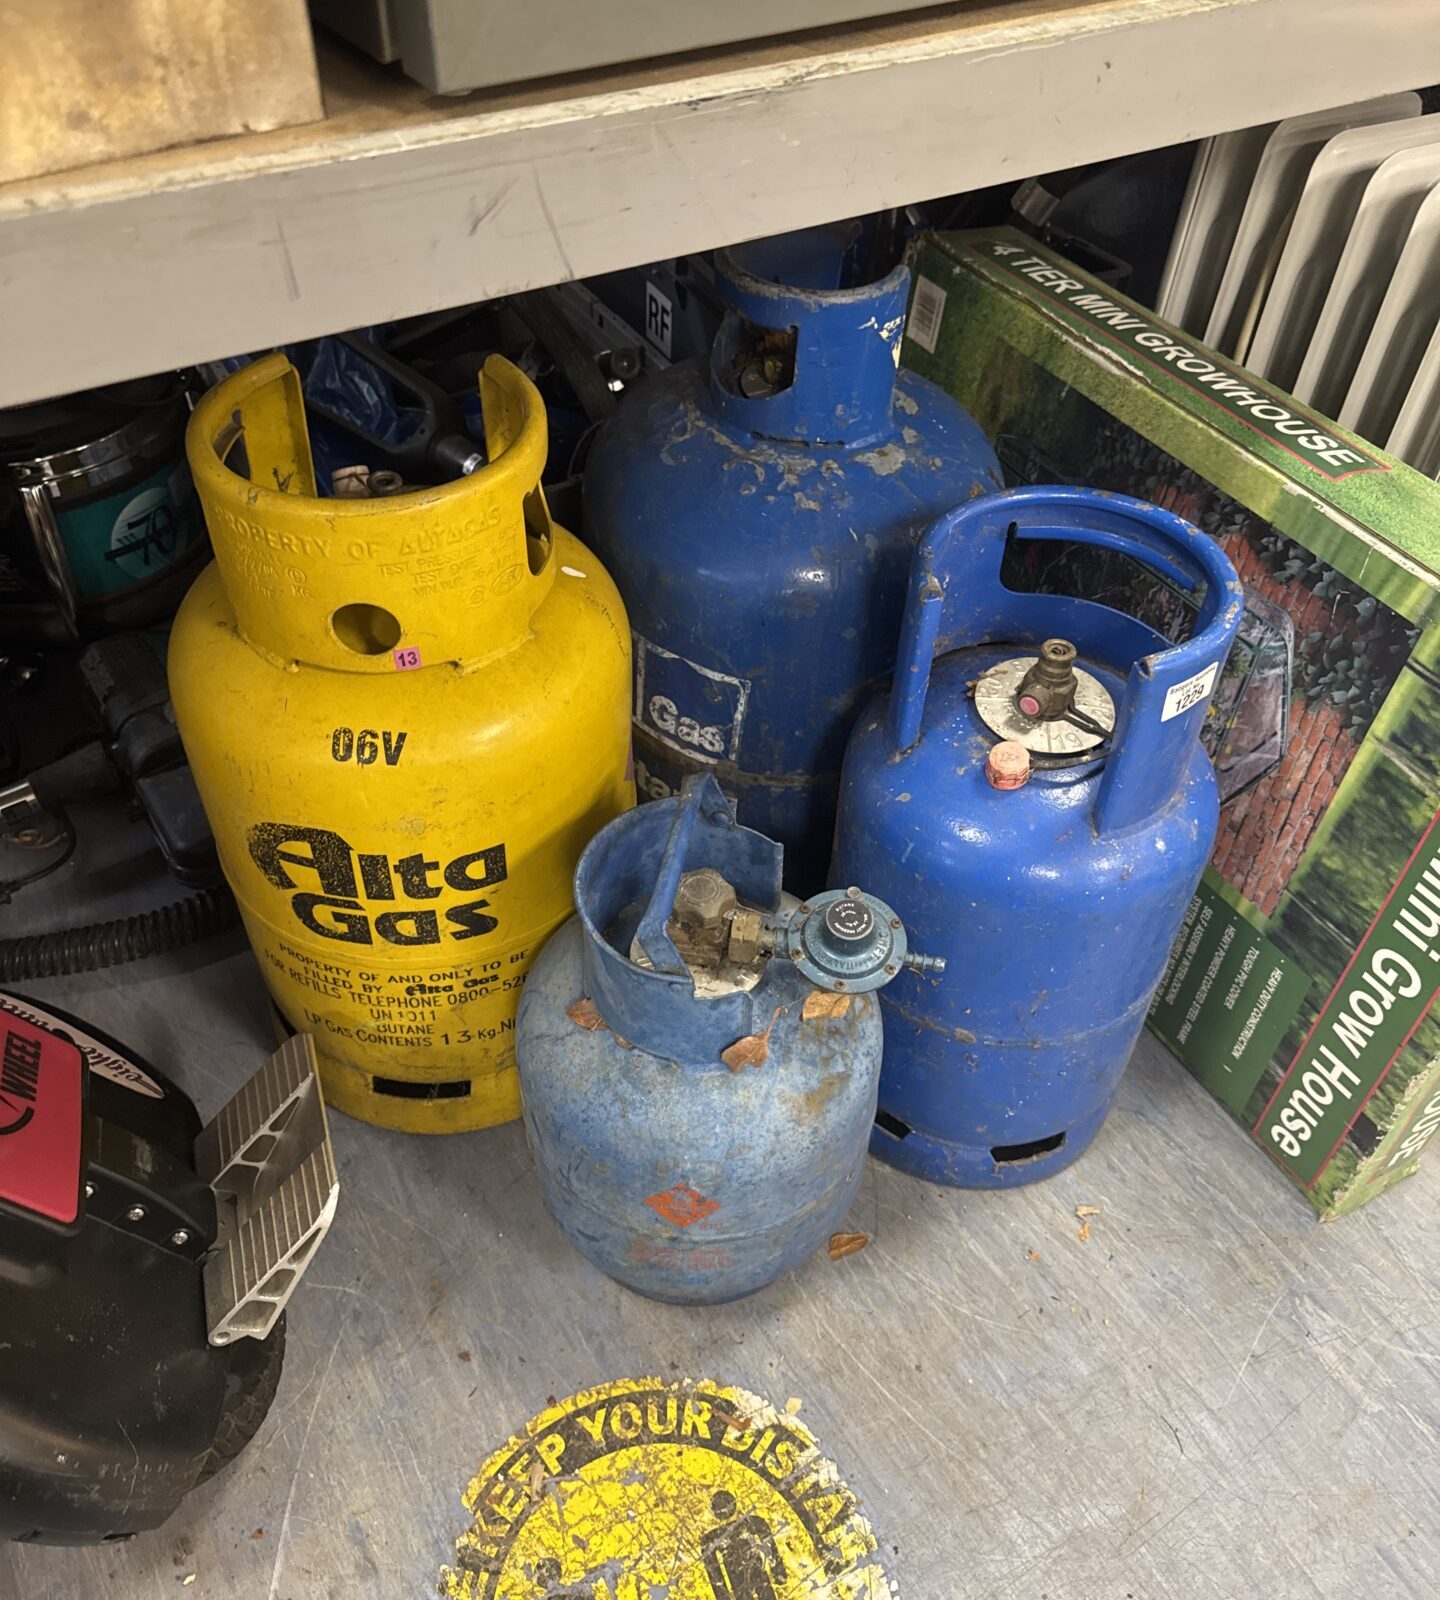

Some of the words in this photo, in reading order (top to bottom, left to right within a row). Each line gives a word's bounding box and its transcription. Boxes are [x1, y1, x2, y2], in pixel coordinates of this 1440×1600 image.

[648, 293, 670, 341] RF
[993, 243, 1025, 256] 4
[1011, 256, 1085, 295] TIER
[1068, 293, 1149, 332] MINI
[1134, 331, 1367, 467] GROWHOUSE
[347, 540, 381, 560] OF
[398, 651, 418, 667] 13
[1175, 683, 1205, 713] 1229
[649, 695, 725, 753] Gas
[332, 727, 408, 767] 06V
[246, 822, 509, 900] Alta
[291, 892, 499, 946] Gas
[1218, 922, 1236, 952] HEAVY
[279, 943, 352, 978] PROPERTY
[359, 972, 381, 982] OF
[388, 974, 423, 984] AND
[429, 967, 474, 983] ONLY
[482, 960, 502, 973] TO
[510, 948, 530, 964] BE
[1206, 945, 1225, 979] POWDER
[1240, 943, 1259, 974] TOUGH
[289, 967, 342, 999] REFILLS
[348, 991, 443, 1009] TELEPHONE
[303, 966, 353, 990] FILLED
[362, 984, 383, 994] BY
[405, 983, 454, 997] Alta
[463, 974, 500, 989] Gas
[1195, 974, 1212, 1004] COATED
[1234, 967, 1247, 988] PVC
[1264, 965, 1283, 994] HEAVY
[1185, 1000, 1201, 1023] STEEL
[1223, 982, 1240, 1010] COVER
[1255, 987, 1271, 1012] DUTY
[1332, 948, 1422, 1060] Grow
[370, 1008, 393, 1021] UN
[376, 1023, 436, 1036] BUTANE
[324, 1018, 353, 1039] GAS
[355, 1029, 433, 1047] CONTENTS
[1176, 1019, 1193, 1044] FRAME
[1230, 1005, 1262, 1061] CONSTRUCTION
[0, 1030, 42, 1102] WHEEL
[1269, 1044, 1362, 1158] House
[574, 1396, 714, 1447] YOUR
